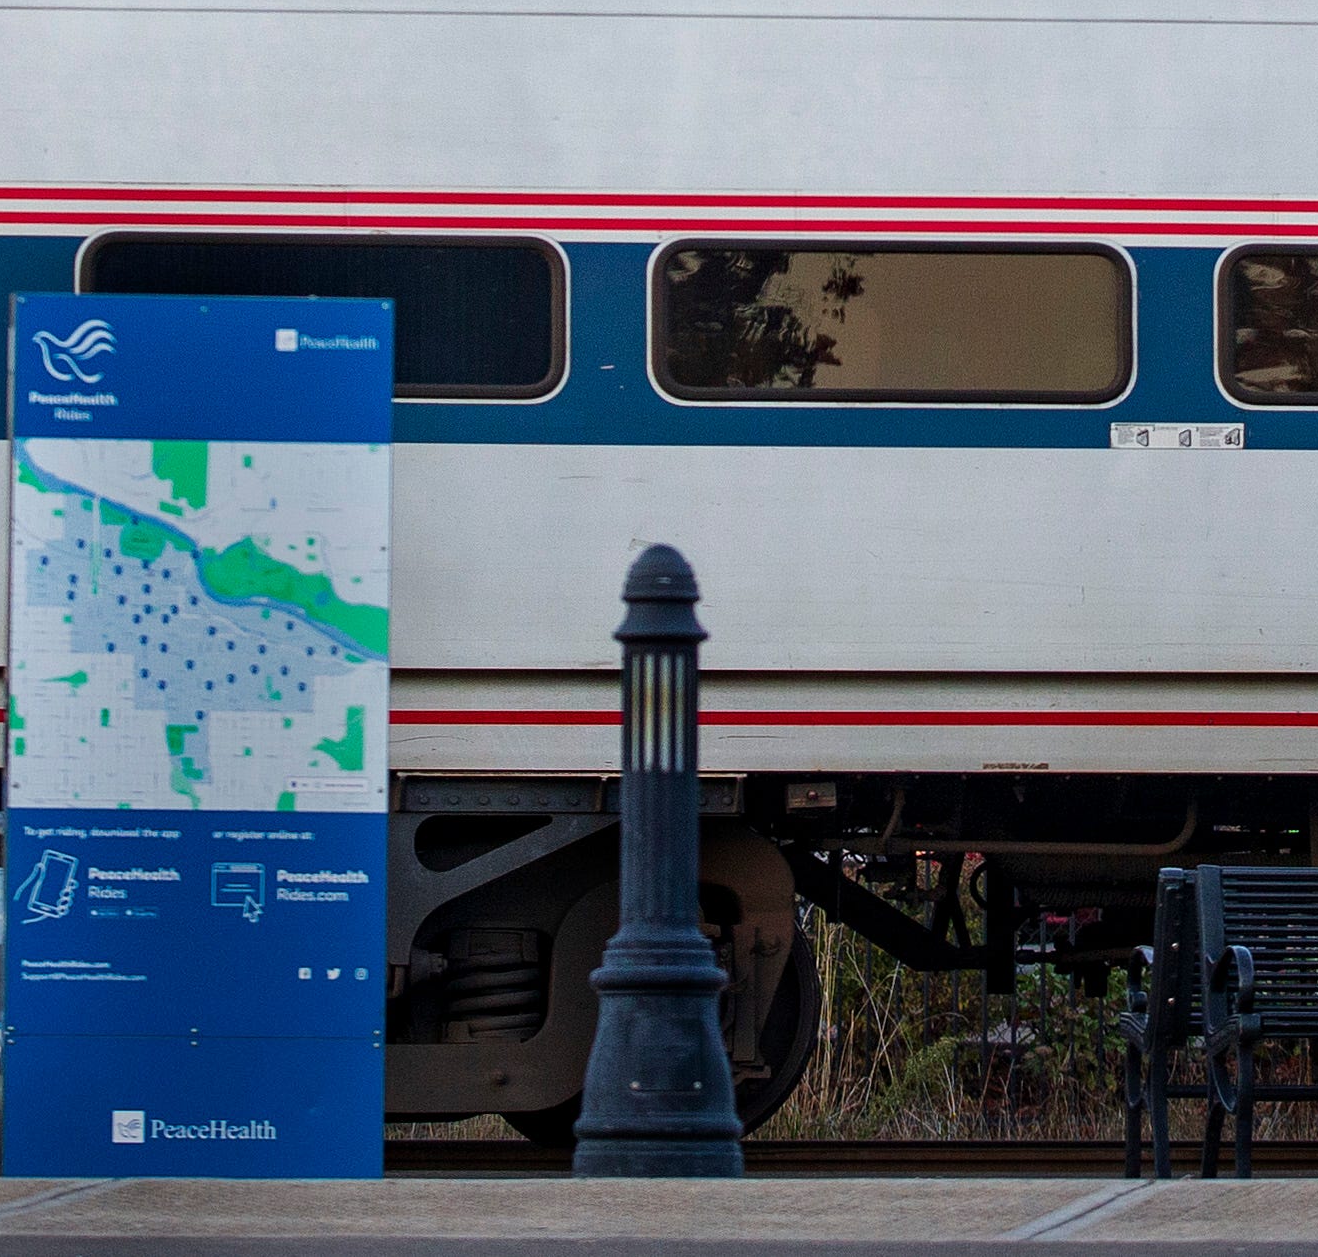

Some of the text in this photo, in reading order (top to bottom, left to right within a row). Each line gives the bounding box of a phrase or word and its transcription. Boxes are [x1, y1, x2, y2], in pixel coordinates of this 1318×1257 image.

[299, 334, 380, 350] PeaceHealth
[28, 390, 119, 406] PeaceHealth
[88, 867, 181, 881] PeaceHealth
[276, 869, 369, 884] PeaceHealth
[88, 885, 128, 899] Rides
[276, 887, 350, 901] Rides.com
[150, 1119, 277, 1140] PeaceHealth
